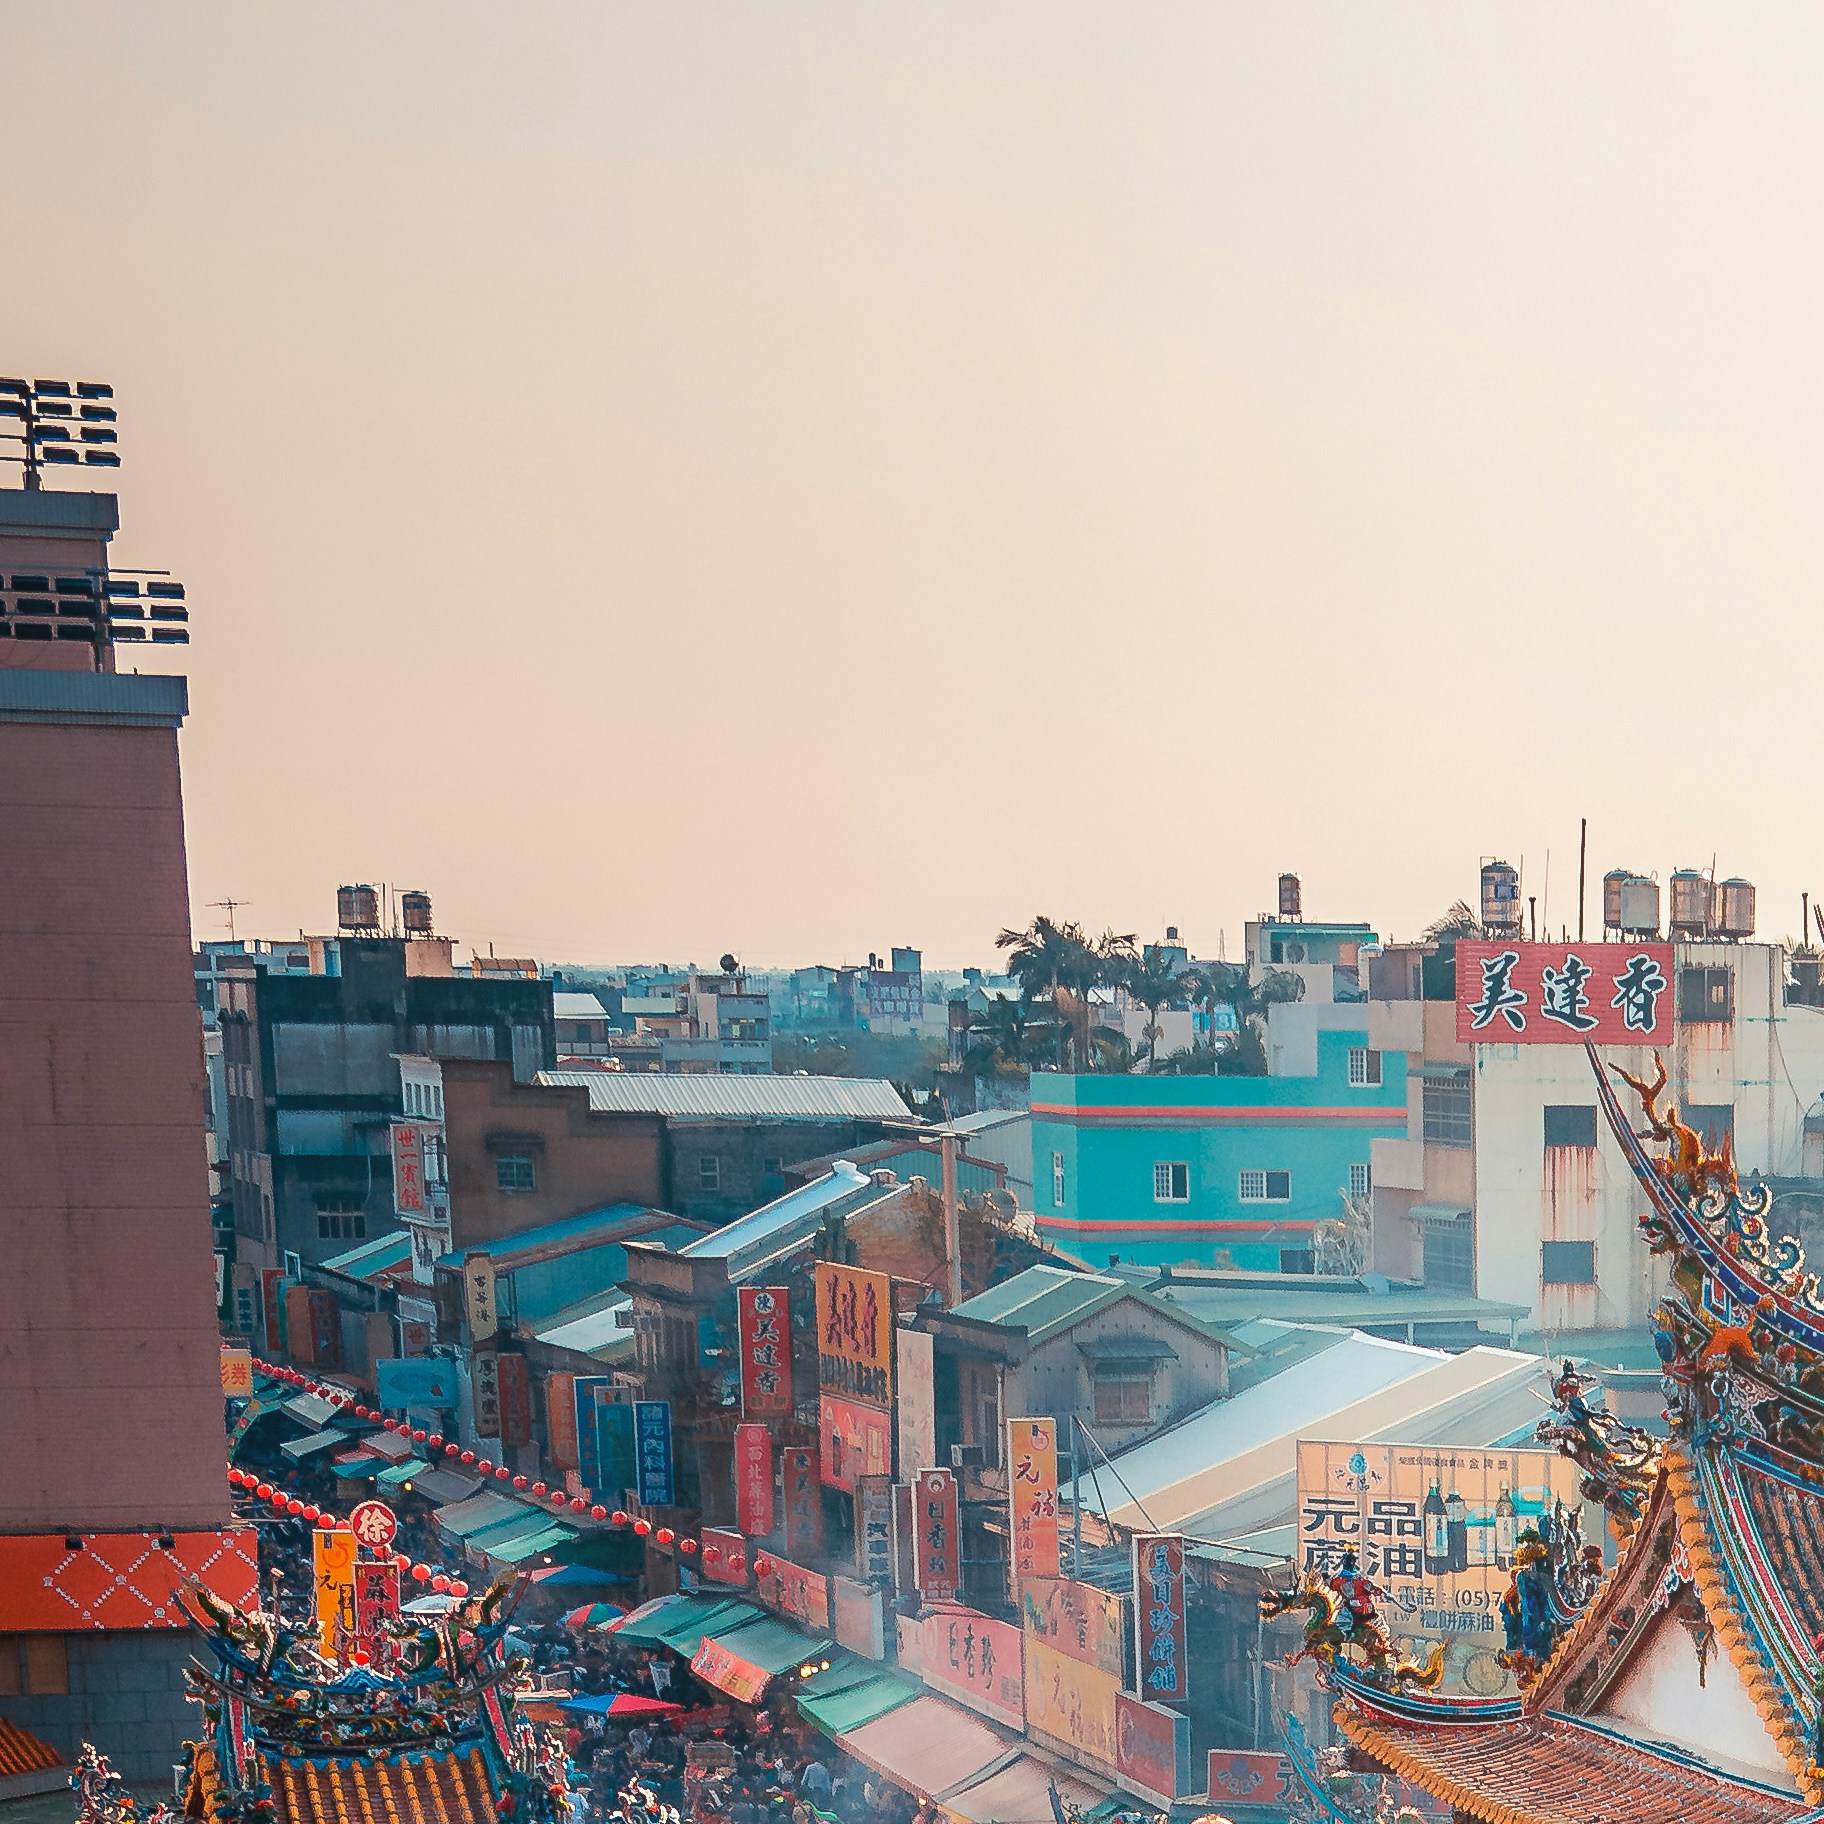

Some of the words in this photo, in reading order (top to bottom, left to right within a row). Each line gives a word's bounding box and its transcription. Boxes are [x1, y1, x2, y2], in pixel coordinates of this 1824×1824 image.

[1467, 951, 1667, 1034] 美達香
[398, 1129, 423, 1210] 世一賓館
[752, 1317, 782, 1396] 美達香
[358, 1506, 393, 1543] 徐
[1302, 1497, 1423, 1537] 元品
